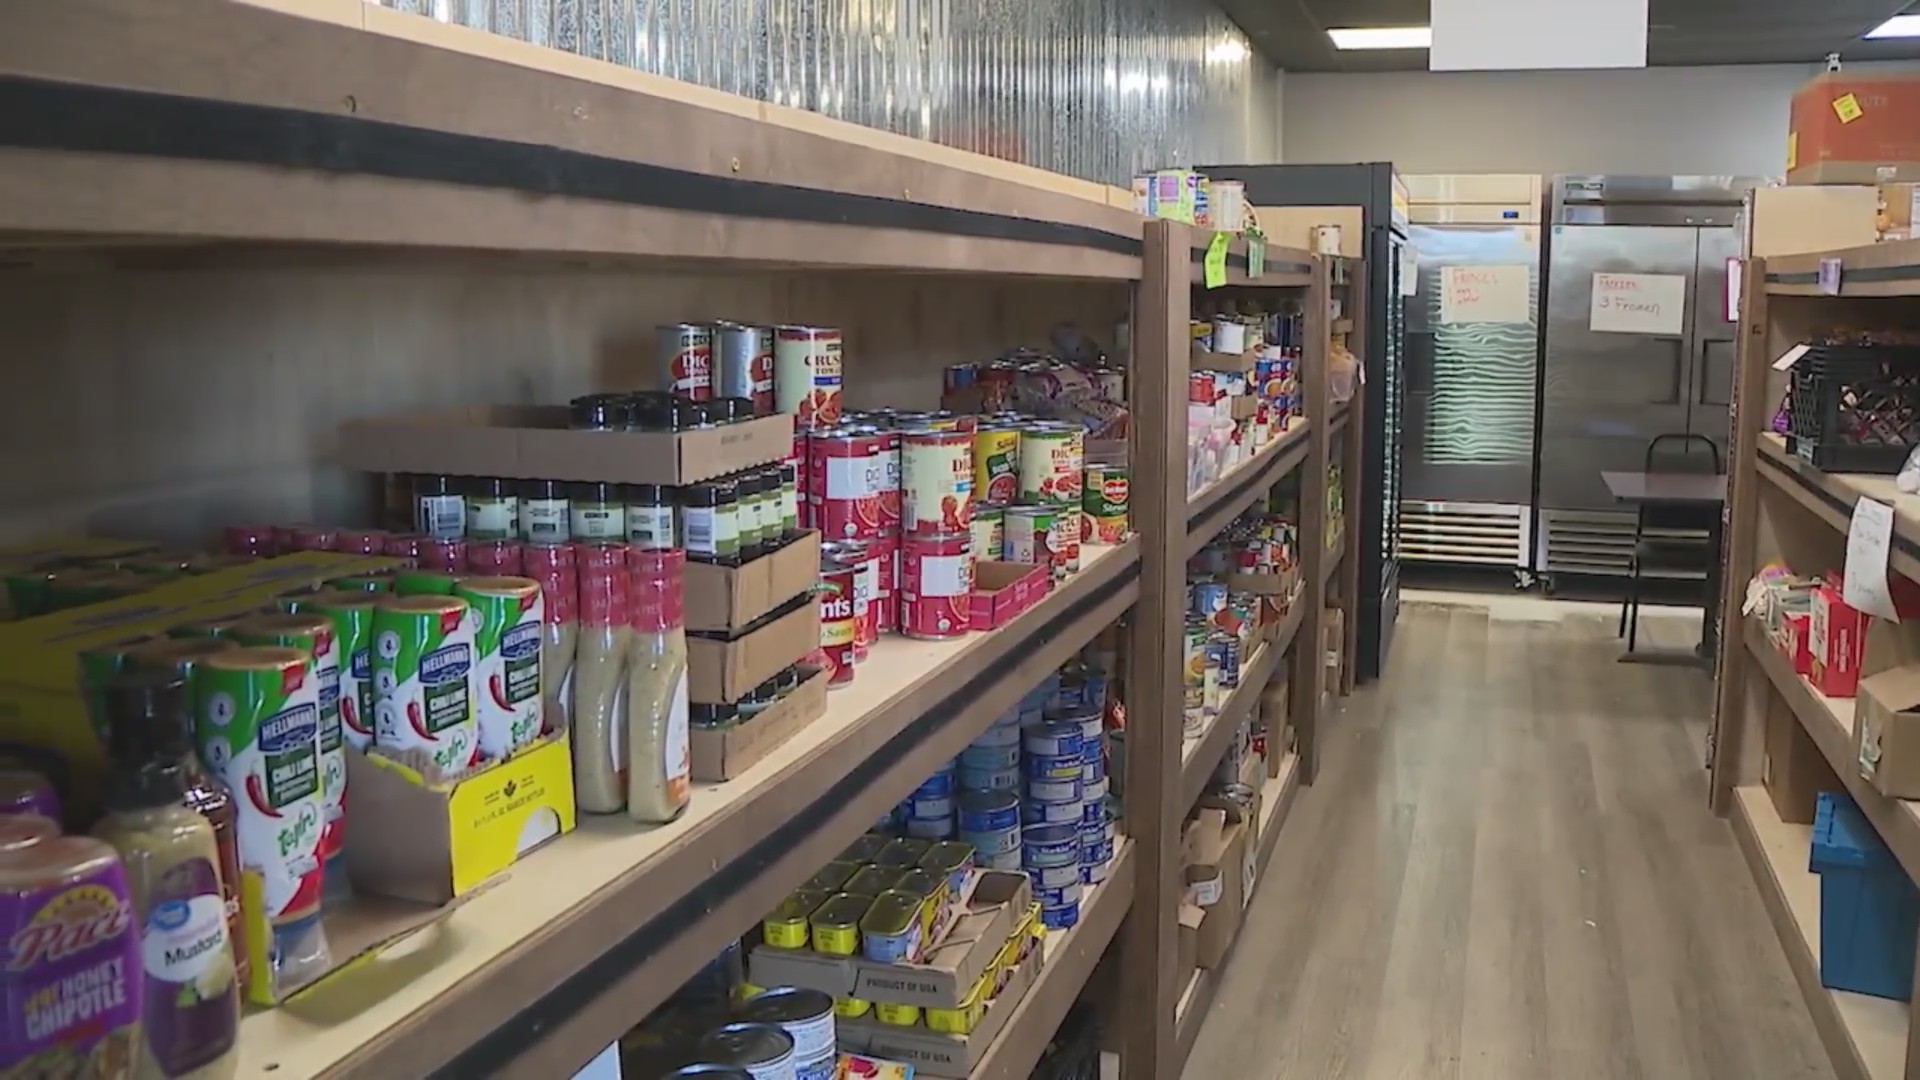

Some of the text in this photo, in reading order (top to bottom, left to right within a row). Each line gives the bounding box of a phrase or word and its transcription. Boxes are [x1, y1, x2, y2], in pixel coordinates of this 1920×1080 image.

[164, 928, 222, 967] Mustard
[61, 956, 124, 1000] HONEY
[866, 978, 937, 993] PRODUCT OF USA
[25, 977, 126, 1040] CHIPOTLE
[921, 1051, 931, 1060] OF
[933, 1053, 951, 1063] USA
